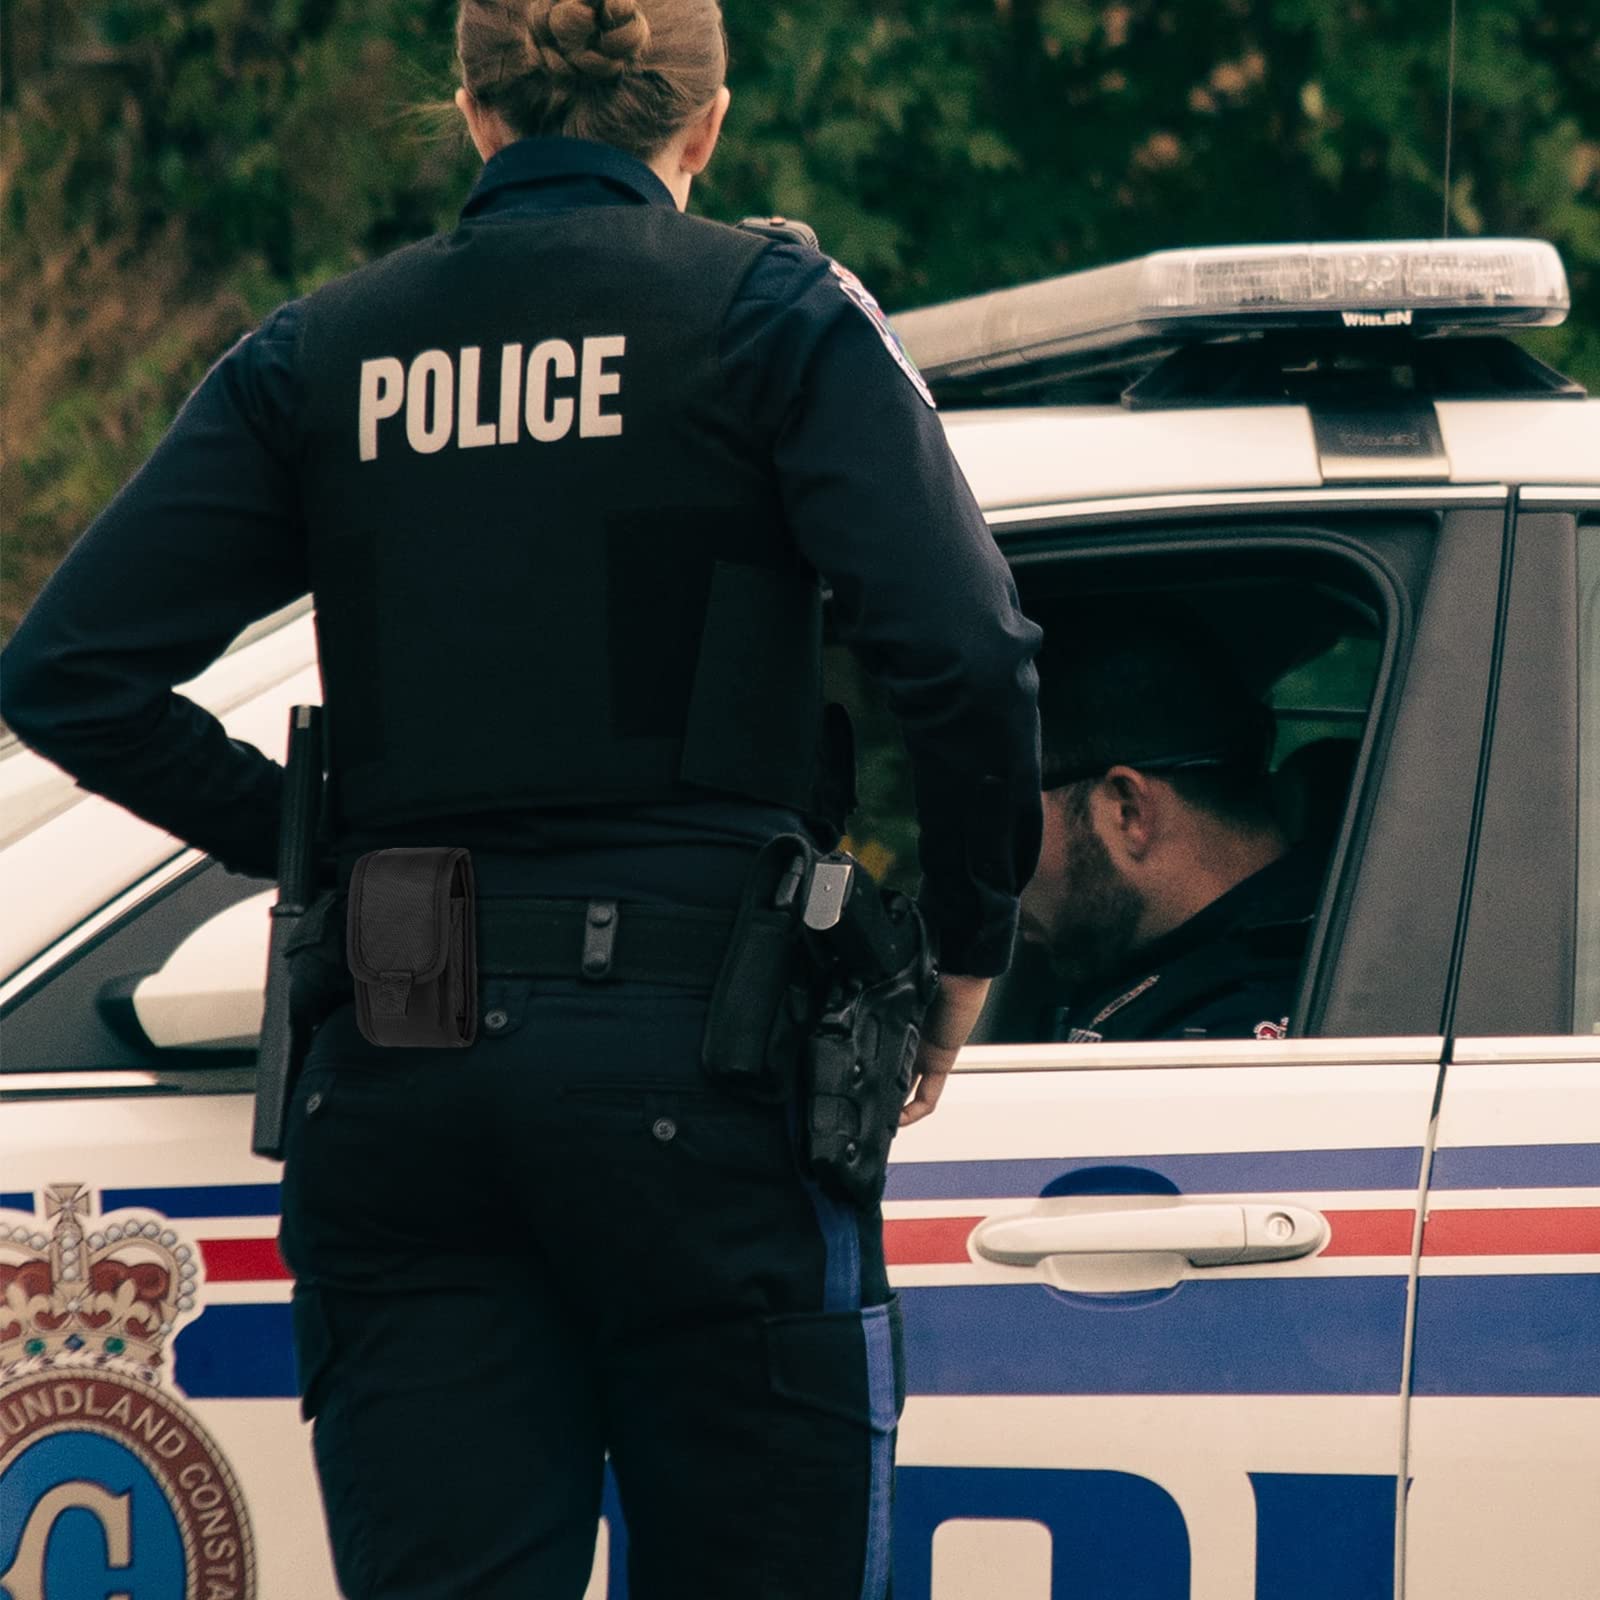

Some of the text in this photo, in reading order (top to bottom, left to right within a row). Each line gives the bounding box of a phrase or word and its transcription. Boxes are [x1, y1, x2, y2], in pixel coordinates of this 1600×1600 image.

[1341, 309, 1413, 327] WHELEN
[358, 335, 626, 462] POLICE
[0, 1384, 187, 1458] UNDLAND
